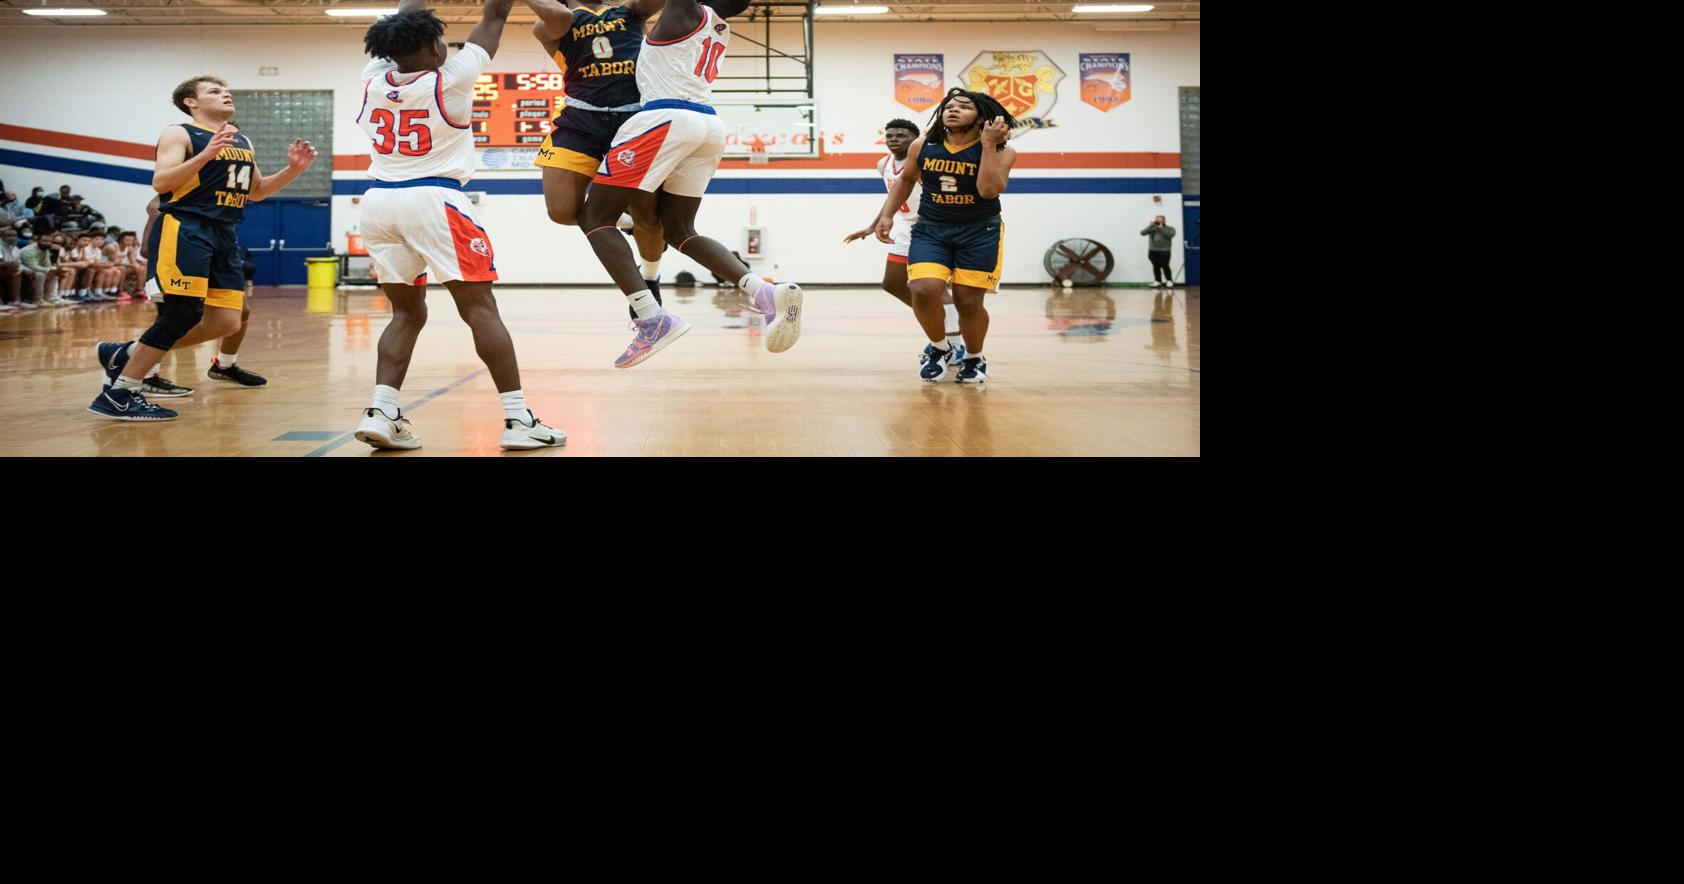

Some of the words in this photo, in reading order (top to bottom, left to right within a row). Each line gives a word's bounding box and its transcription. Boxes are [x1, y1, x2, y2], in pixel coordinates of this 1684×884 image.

[572, 18, 626, 41] MOUNT
[592, 36, 614, 59] 0
[578, 60, 635, 78] TABOR
[693, 36, 726, 84] 10
[895, 63, 943, 72] CHAMPIONS
[1080, 62, 1129, 71] CHAMPIONS
[516, 74, 563, 90] 5:58
[369, 108, 432, 156] 35
[922, 157, 977, 175] MOUNT
[226, 164, 251, 190] 14
[938, 175, 958, 192] 2
[931, 193, 975, 204] TABOR
[170, 278, 191, 290] MT
